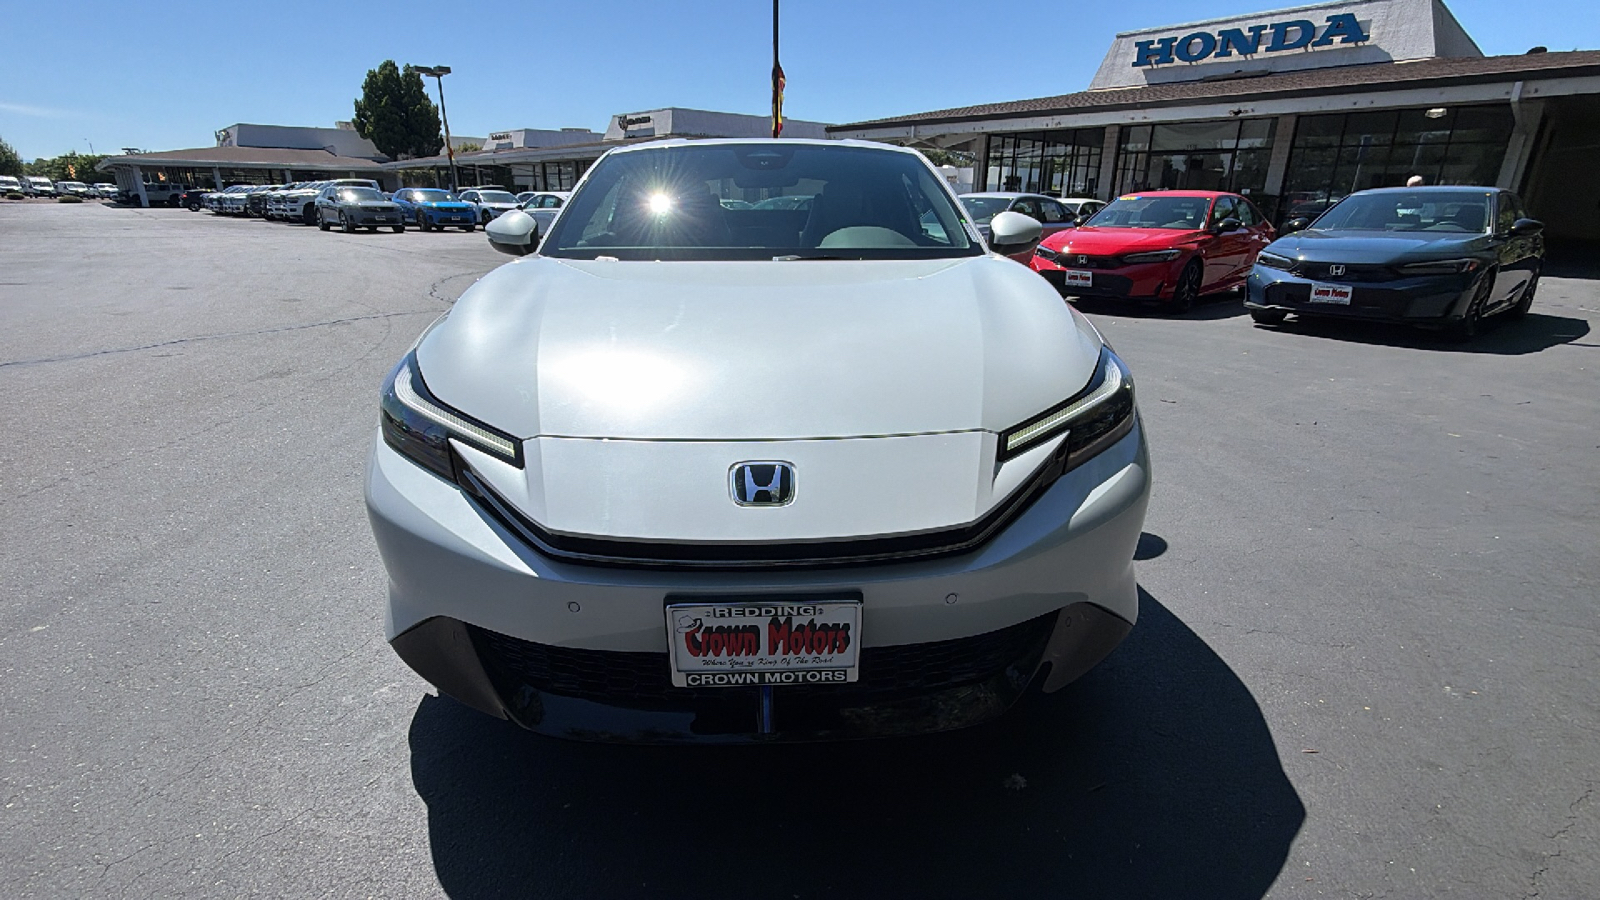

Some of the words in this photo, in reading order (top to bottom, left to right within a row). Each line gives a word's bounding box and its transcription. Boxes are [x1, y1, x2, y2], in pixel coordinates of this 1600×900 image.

[1132, 13, 1370, 67] HONDA
[715, 606, 815, 617] REDDING
[685, 618, 760, 657] Crown
[768, 617, 850, 656] Motors
[702, 659, 726, 667] Where
[758, 657, 777, 667] King
[780, 657, 790, 667] Of
[794, 656, 808, 665] The
[811, 656, 834, 665] Road
[688, 673, 759, 686] CROWN
[766, 671, 846, 683] MOTORS
